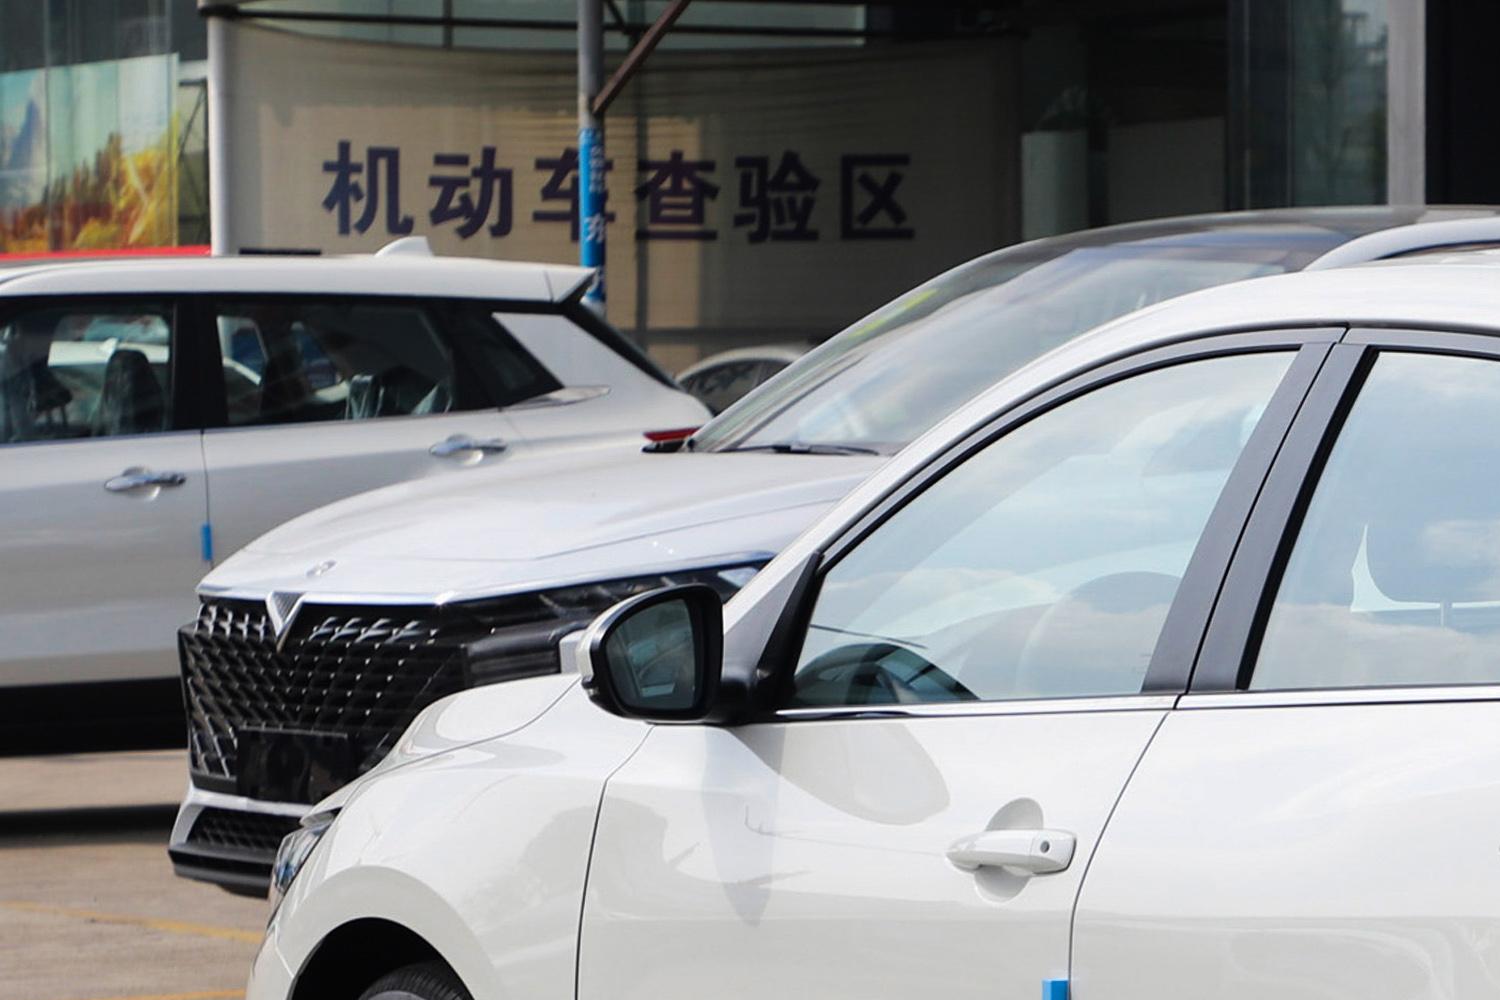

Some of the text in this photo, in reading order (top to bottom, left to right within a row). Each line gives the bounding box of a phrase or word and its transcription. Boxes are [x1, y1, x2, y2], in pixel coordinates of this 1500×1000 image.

[322, 139, 915, 243] 机动车查验区
